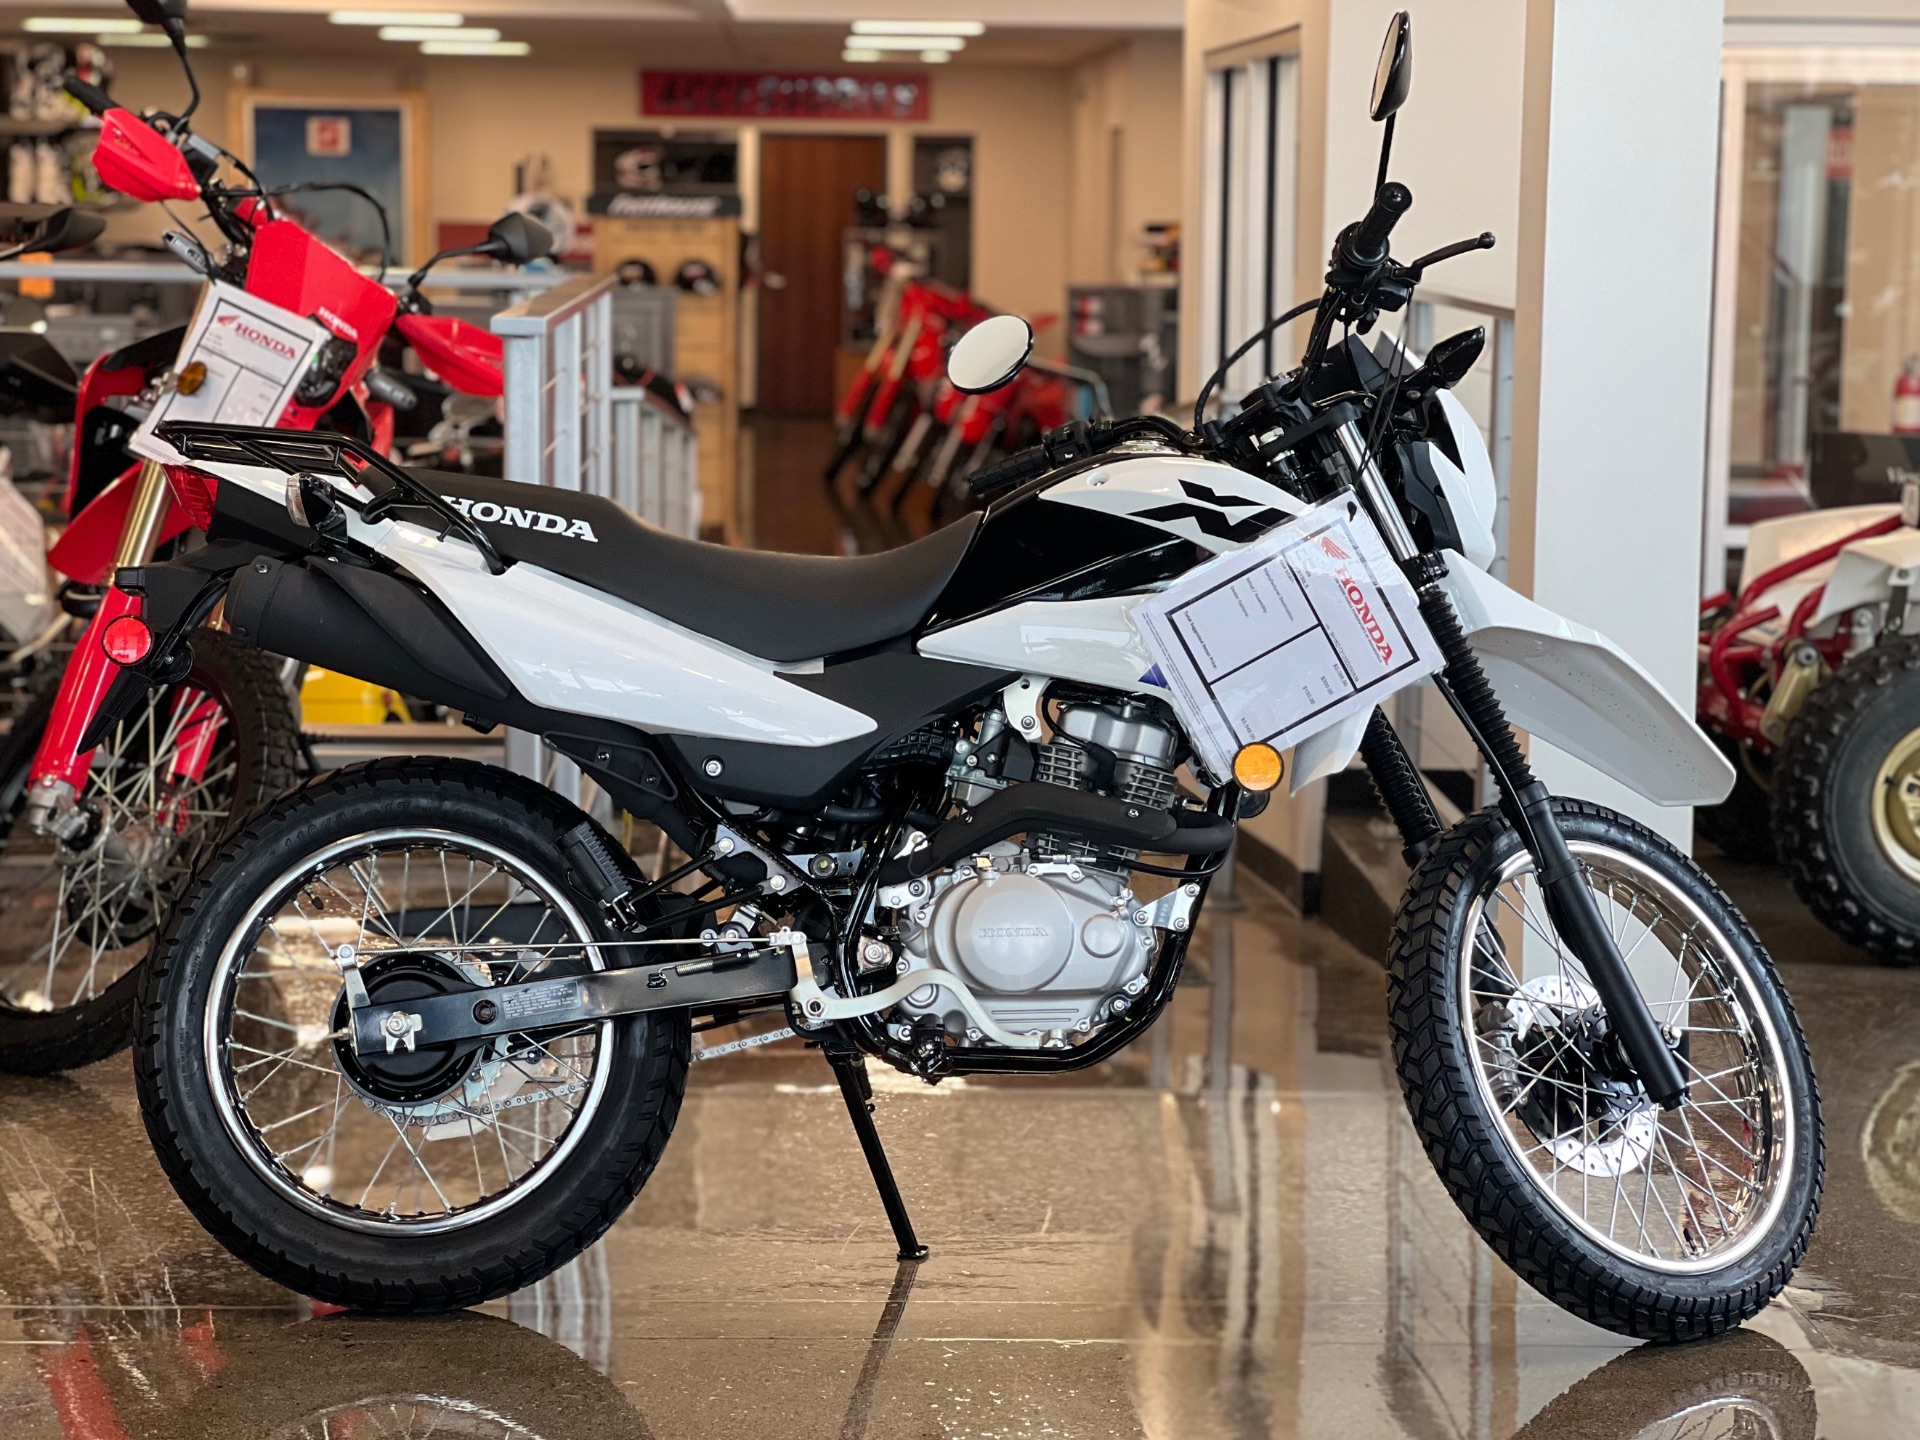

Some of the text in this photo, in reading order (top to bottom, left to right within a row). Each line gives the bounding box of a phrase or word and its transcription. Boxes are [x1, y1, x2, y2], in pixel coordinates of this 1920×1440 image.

[318, 306, 358, 339] HONDA
[235, 322, 297, 359] HONDA
[441, 495, 598, 543] HONDA
[1230, 585, 1240, 600] Dealer
[1263, 567, 1281, 596] Manufacturer
[1334, 567, 1393, 665] HONDA
[1184, 610, 1218, 670] Total Suggested Retail Price:
[1302, 685, 1316, 705] $150.00
[1320, 675, 1334, 695] $300.00
[978, 927, 1049, 938] HONDA
